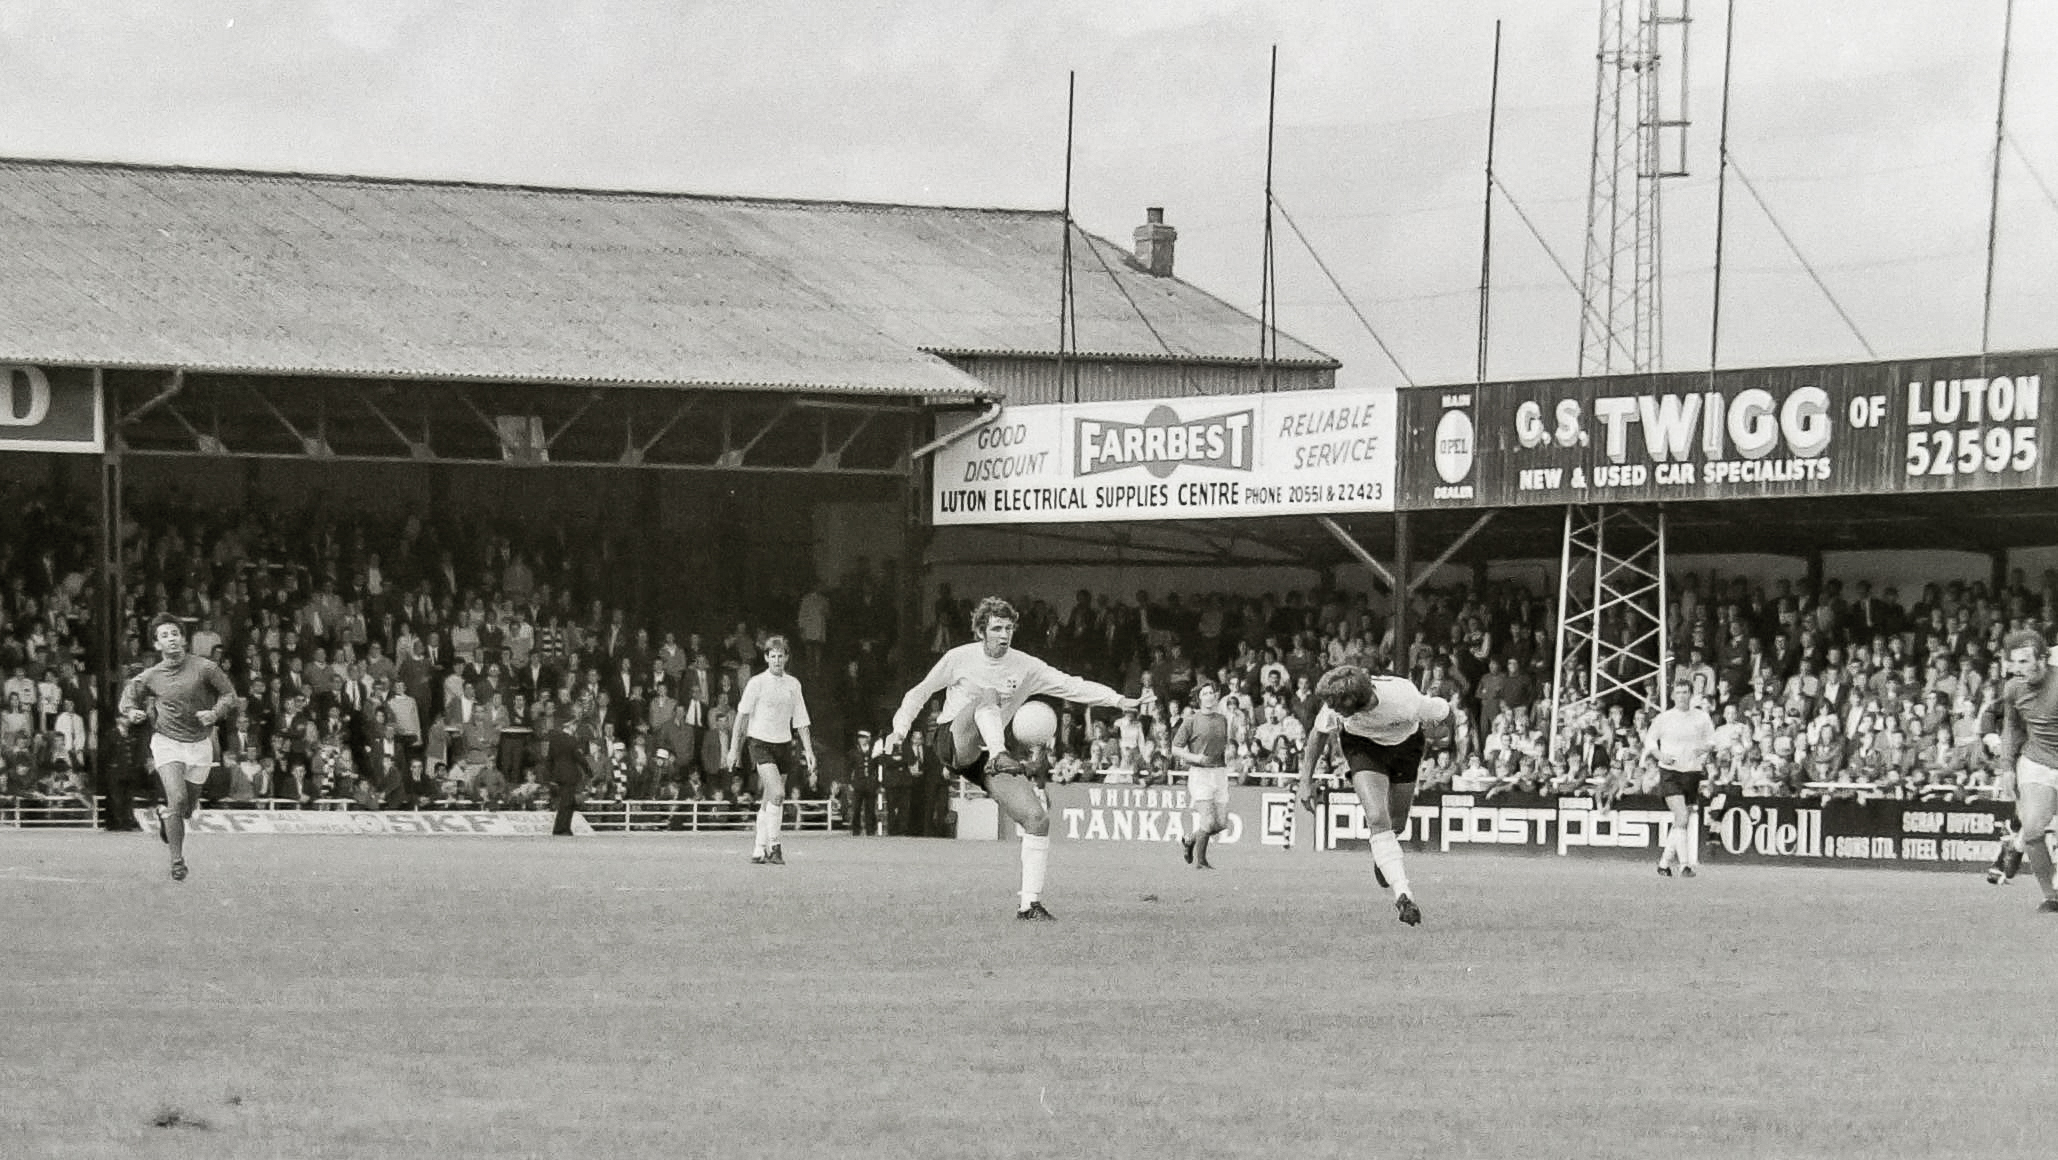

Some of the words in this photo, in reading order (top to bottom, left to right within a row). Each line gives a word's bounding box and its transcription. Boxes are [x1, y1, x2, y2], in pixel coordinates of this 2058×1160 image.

[1908, 375, 2040, 425] LUTON
[978, 424, 1027, 449] GOOD
[1279, 404, 1375, 438] RELIABLE
[1516, 398, 1590, 448] G.S.
[1594, 386, 1832, 464] TWIGG
[1850, 395, 1886, 428] OF
[1080, 413, 1249, 474] FARRBEST
[1294, 437, 1378, 470] SERVICE
[1440, 438, 1468, 454] OPEL
[1906, 426, 2037, 476] 52595
[964, 451, 1048, 482] DISCOUNT
[1519, 467, 1563, 490] NEW
[1570, 467, 1587, 489] &
[1593, 464, 1646, 487] USED
[1655, 463, 1695, 484] CAR
[1703, 457, 1831, 484] SPECIALISTS
[941, 489, 986, 512] LUTON
[994, 487, 1087, 511] ELECTRICAL
[1095, 484, 1168, 508] SUPPLIES
[1178, 481, 1239, 506] CENTRE
[1245, 486, 1282, 504] PHONE
[1289, 484, 1322, 503] 20551
[1326, 485, 1335, 502] &
[1338, 482, 1382, 501] 22423
[1088, 788, 1197, 809] WHITBRE
[1720, 805, 1823, 856] O'dell
[1902, 838, 1938, 860] STEEL
